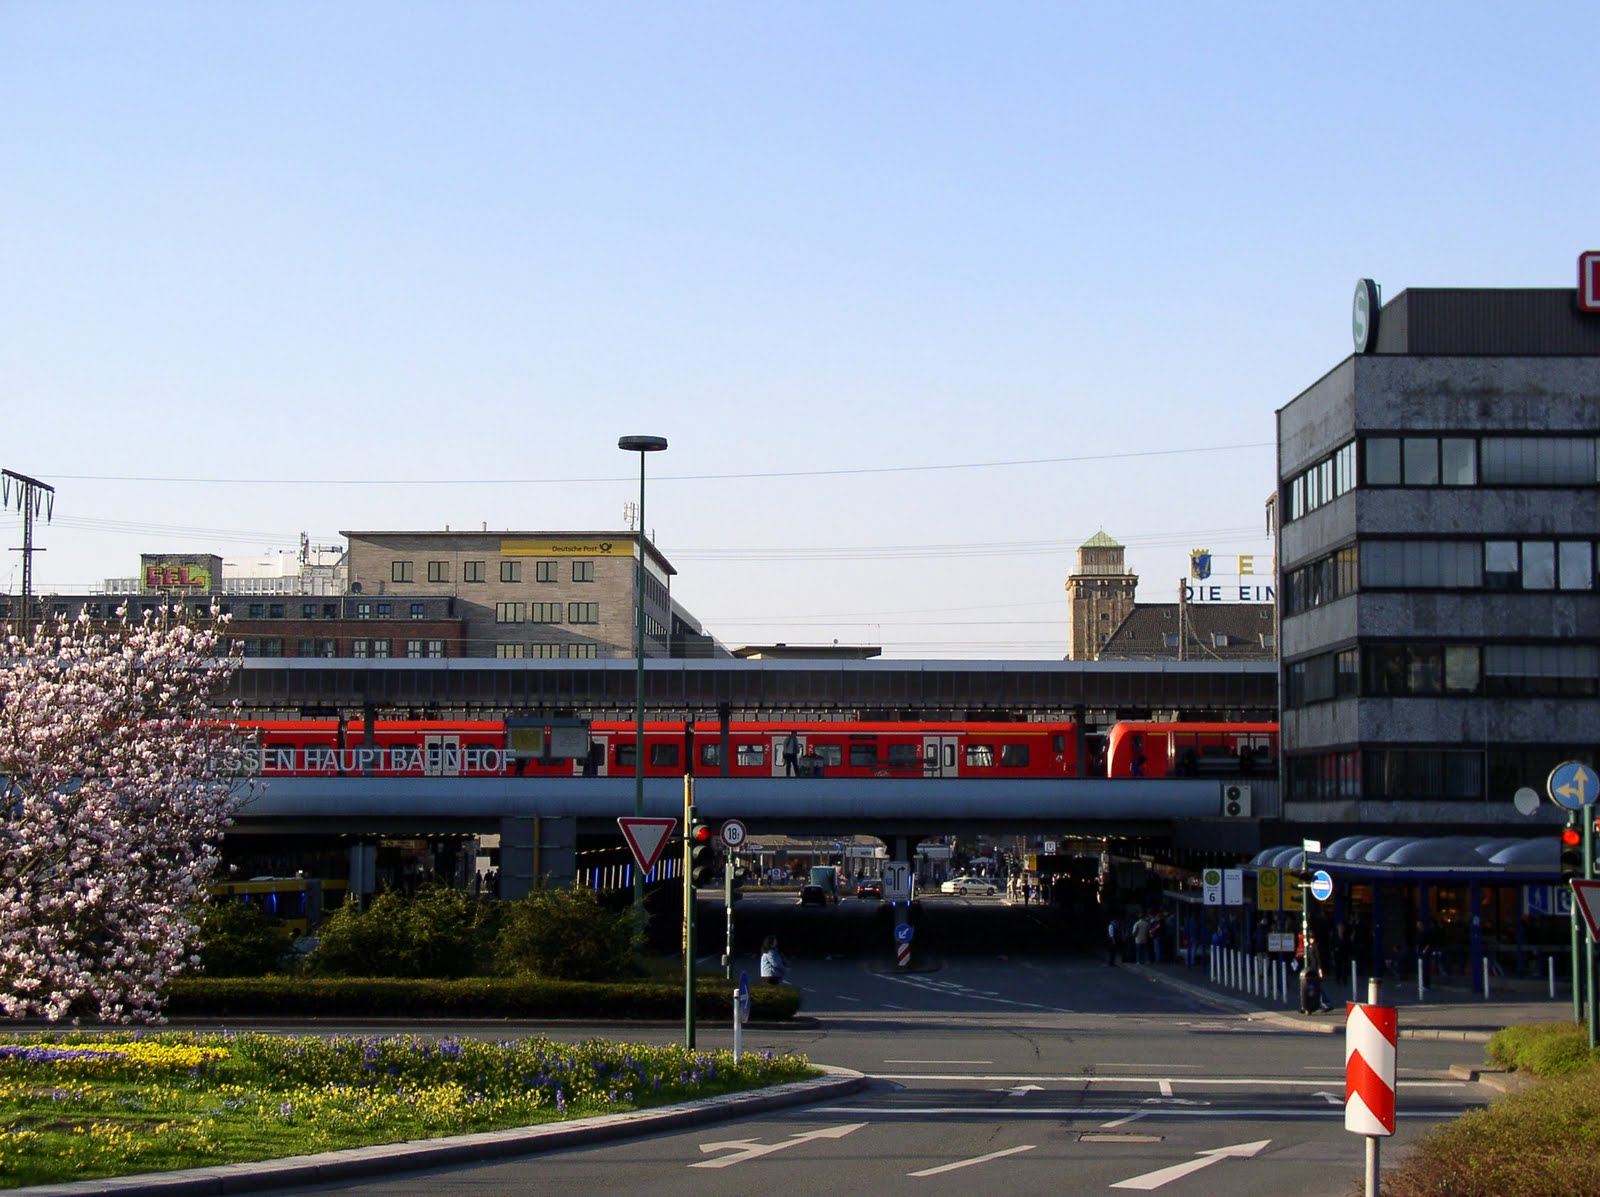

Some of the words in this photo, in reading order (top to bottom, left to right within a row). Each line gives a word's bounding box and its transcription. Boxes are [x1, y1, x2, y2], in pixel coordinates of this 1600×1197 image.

[1355, 291, 1366, 344] S
[1185, 586, 1221, 601] DIE
[304, 749, 516, 772] HAUPTBAHNHOF
[1209, 893, 1216, 902] 6
